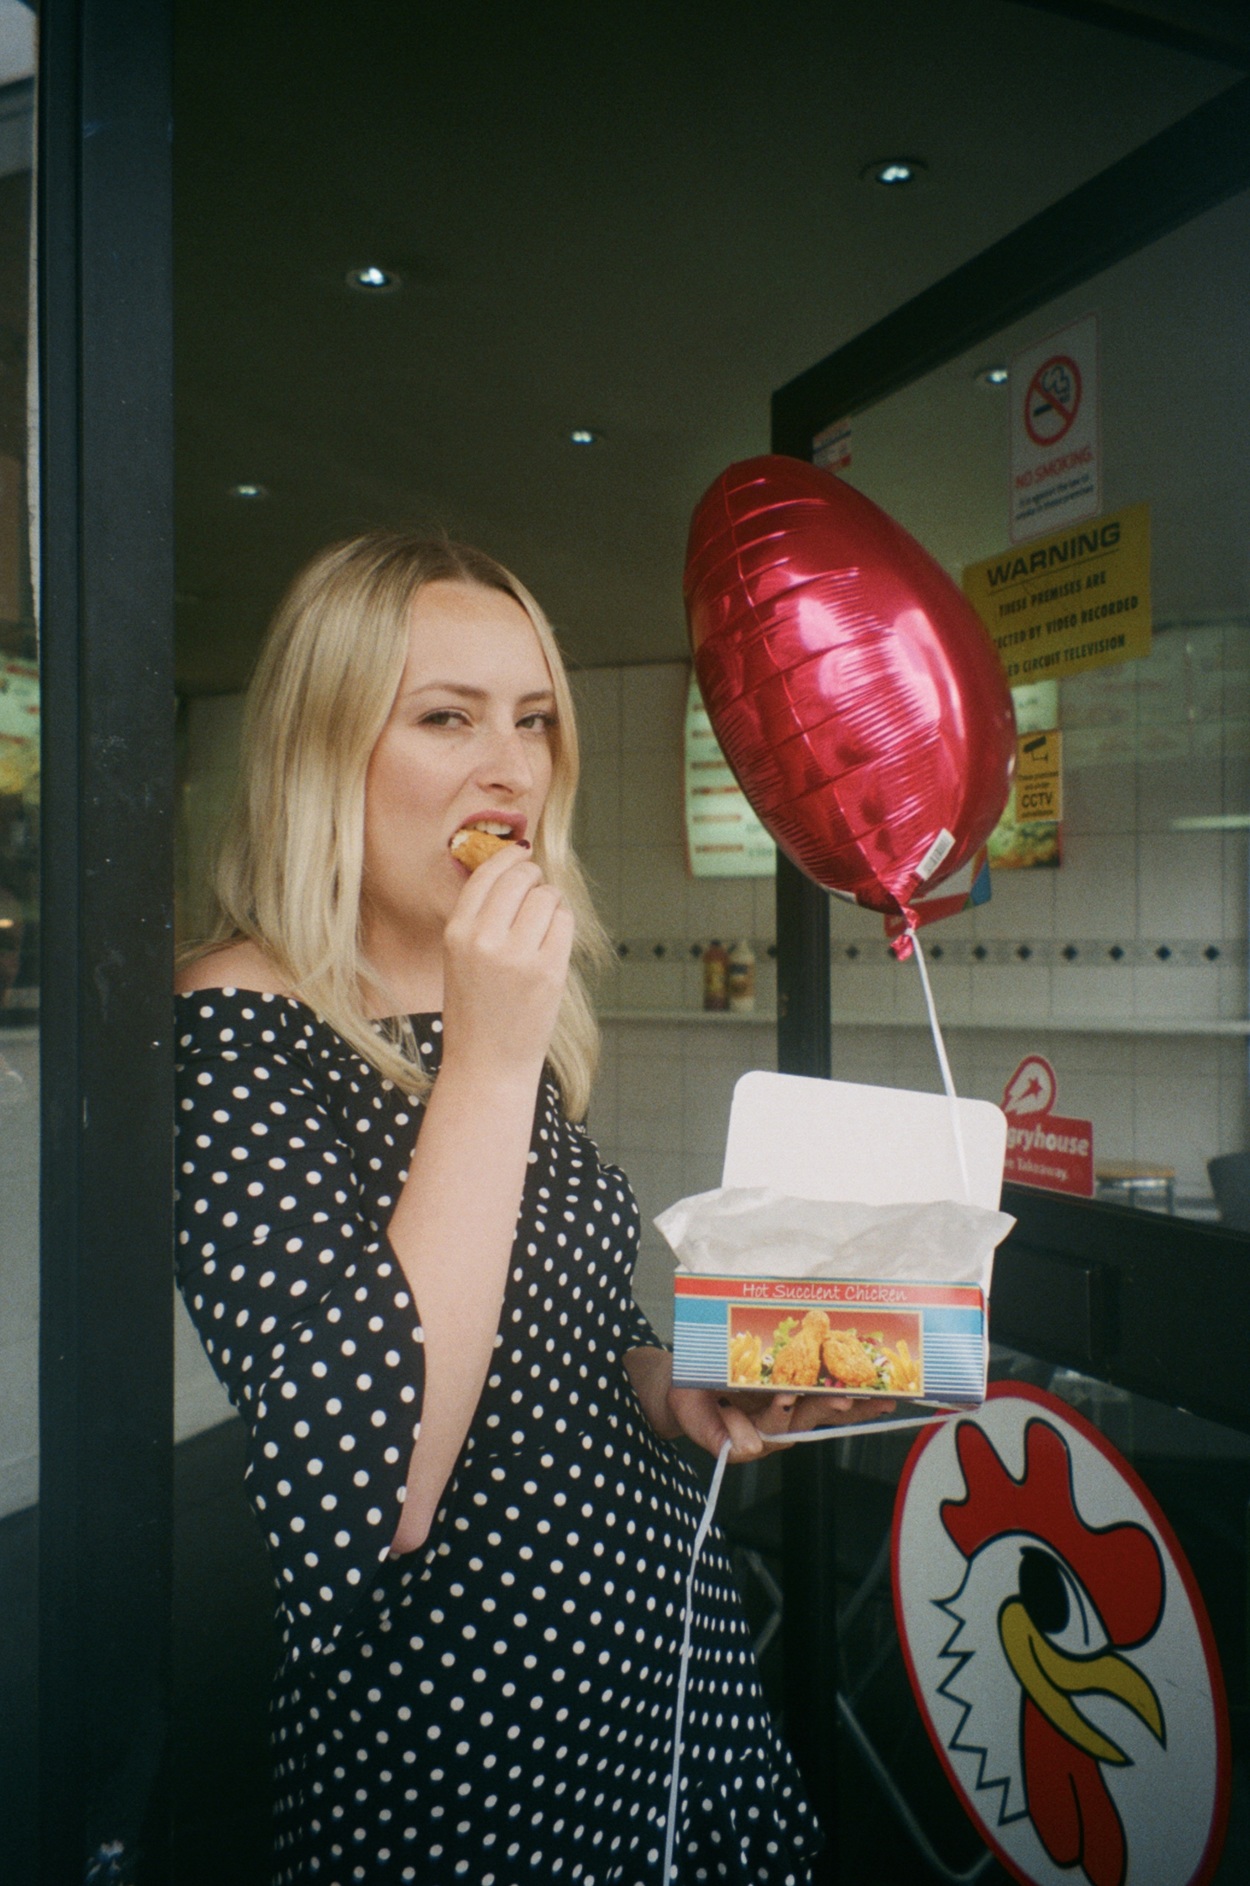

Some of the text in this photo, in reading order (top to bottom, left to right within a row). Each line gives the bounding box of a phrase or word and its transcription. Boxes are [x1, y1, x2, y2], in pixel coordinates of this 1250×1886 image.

[1015, 446, 1093, 489] NO SMOKING
[987, 522, 1121, 587] WARNING
[999, 571, 1107, 618] THESE PREMISES ARE
[994, 595, 1139, 650] ECTED BY VIDEO RECORDED
[1022, 651, 1061, 673] CIRCUIT
[1064, 633, 1126, 662] TELEVISION
[1021, 791, 1053, 808] CCTV
[742, 1283, 908, 1301] Hot Succlent Chicken
